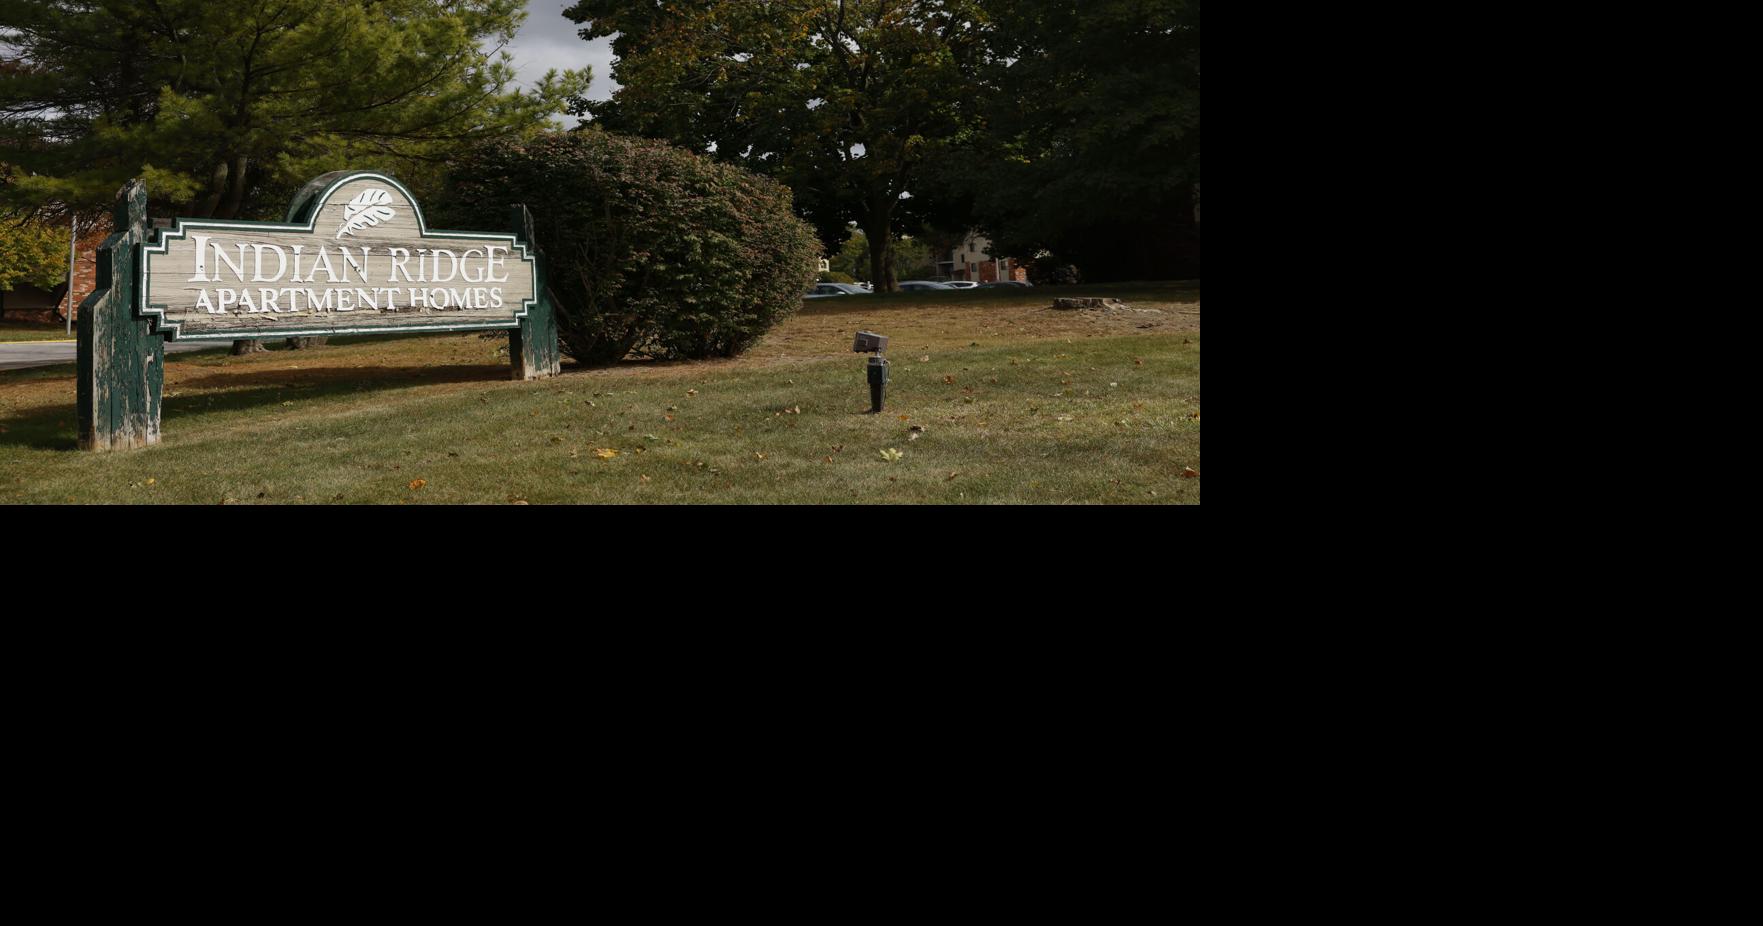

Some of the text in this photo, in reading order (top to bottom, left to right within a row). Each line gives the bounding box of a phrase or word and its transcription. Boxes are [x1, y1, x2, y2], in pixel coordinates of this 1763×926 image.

[187, 235, 509, 283] INDIAN RIDGE
[194, 286, 503, 314] APARTMENT HOMES
